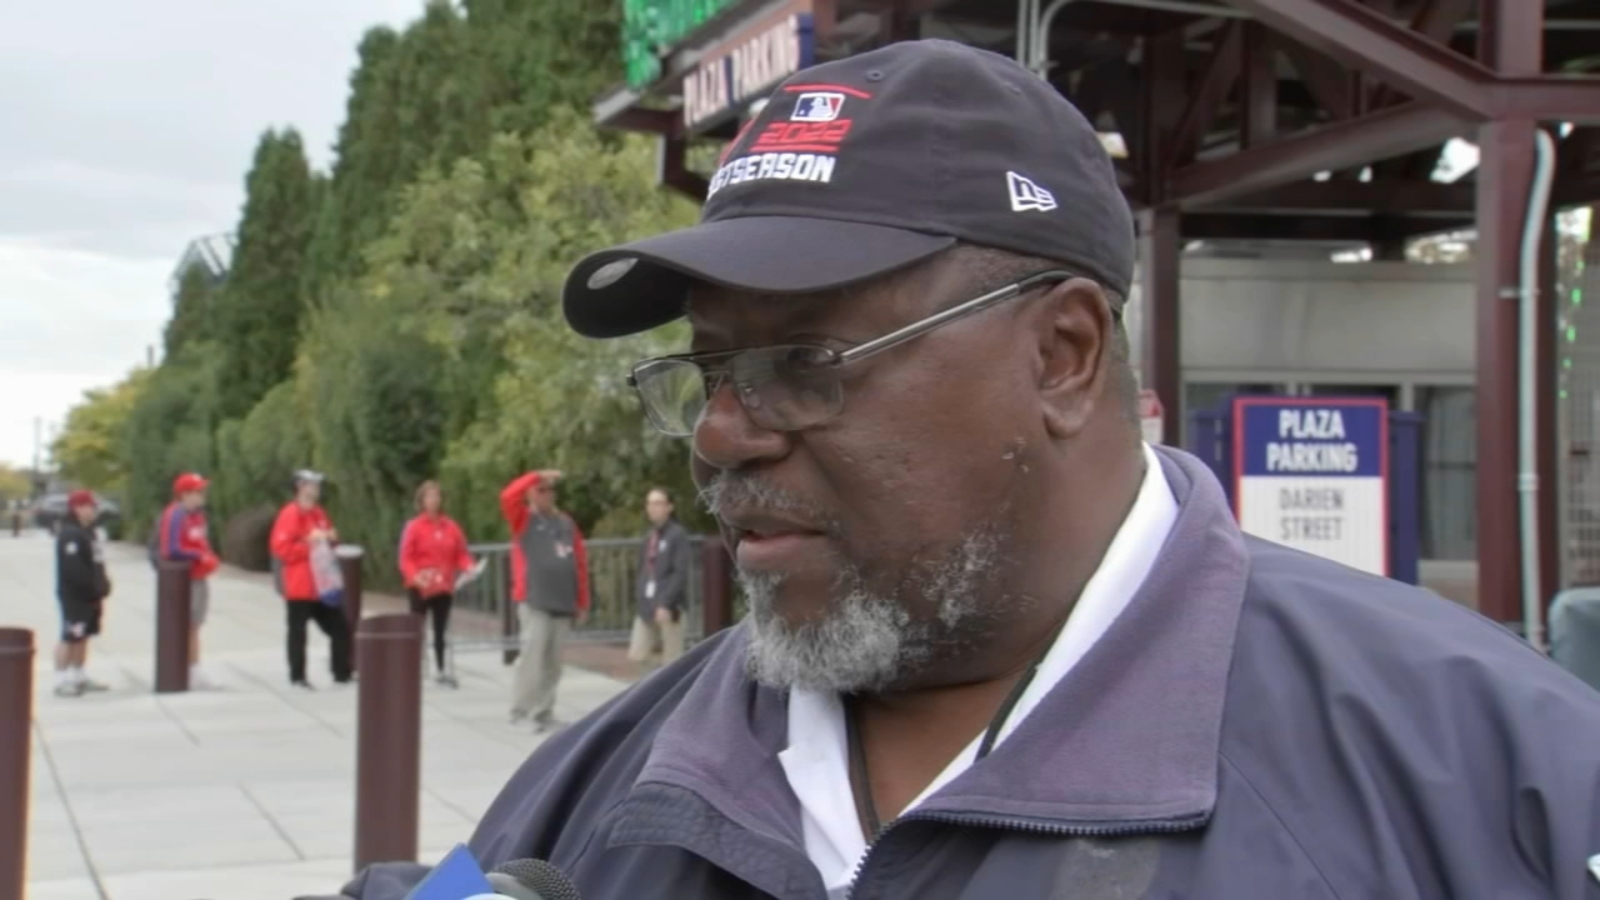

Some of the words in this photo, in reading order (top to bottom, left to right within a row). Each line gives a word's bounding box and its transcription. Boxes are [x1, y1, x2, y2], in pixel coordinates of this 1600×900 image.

[683, 56, 729, 127] PLAZA
[732, 13, 800, 101] PARKING
[757, 120, 852, 142] 2022
[1279, 409, 1345, 438] PLAZA
[1266, 442, 1358, 472] PARKING
[1279, 488, 1343, 510] DARIEN
[1280, 517, 1342, 540] STREET
